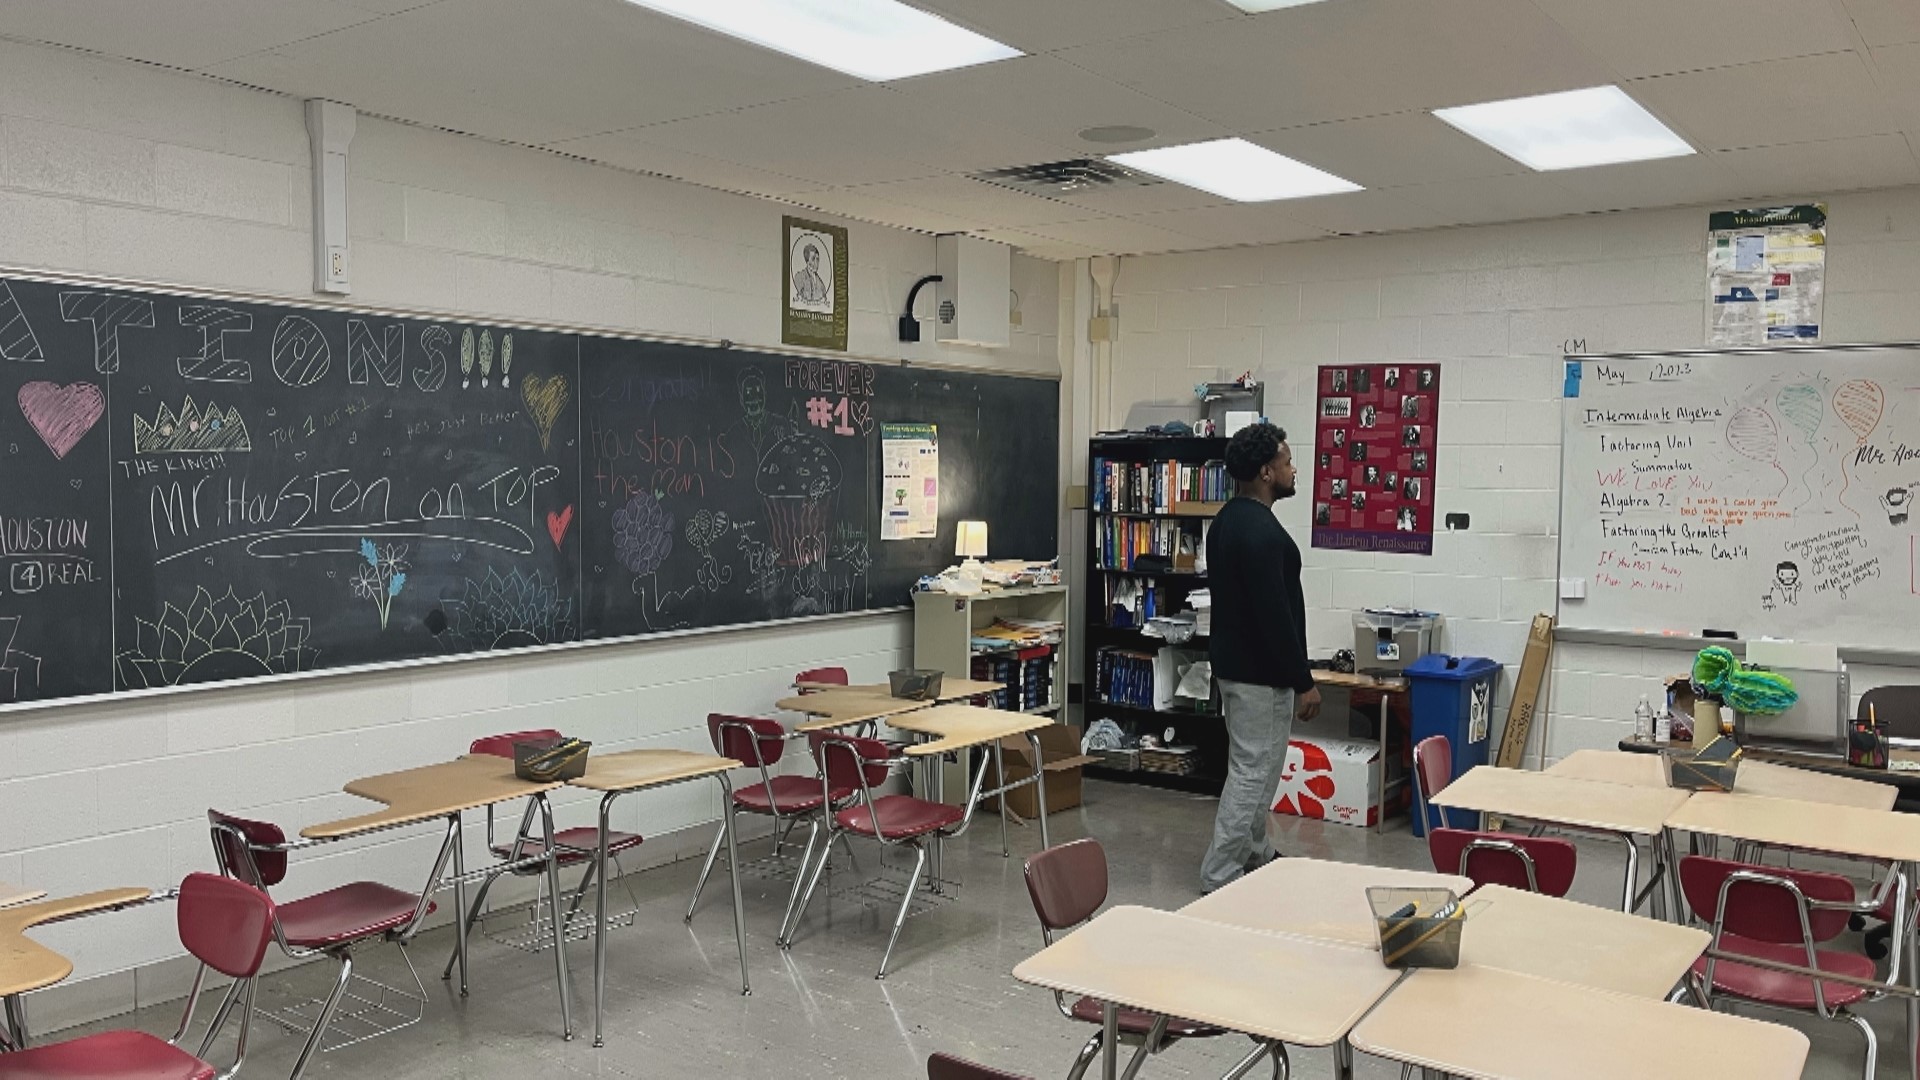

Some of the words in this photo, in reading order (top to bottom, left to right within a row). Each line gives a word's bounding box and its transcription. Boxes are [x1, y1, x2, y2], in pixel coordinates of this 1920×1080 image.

[784, 360, 875, 396] FOREVER
[1597, 365, 1625, 385] May
[805, 397, 855, 436] #1
[1584, 408, 1671, 423] Intermediate
[1676, 407, 1723, 424] Algebra
[589, 417, 697, 467] Houston
[1601, 434, 1661, 458] Factoring
[1667, 435, 1692, 449] Unit
[117, 459, 159, 479] THE
[1632, 459, 1692, 473] Summative
[594, 458, 645, 499] the
[419, 482, 466, 520] on
[1600, 493, 1650, 516] Algebra
[1657, 493, 1671, 507] 2
[1317, 532, 1334, 545] The
[1335, 533, 1370, 549] Harlem
[1371, 535, 1428, 551] Renaissance
[1600, 519, 1658, 545] Factoring
[1681, 523, 1730, 539] Greatest
[1670, 541, 1703, 557] Factor
[48, 562, 102, 585] REAL
